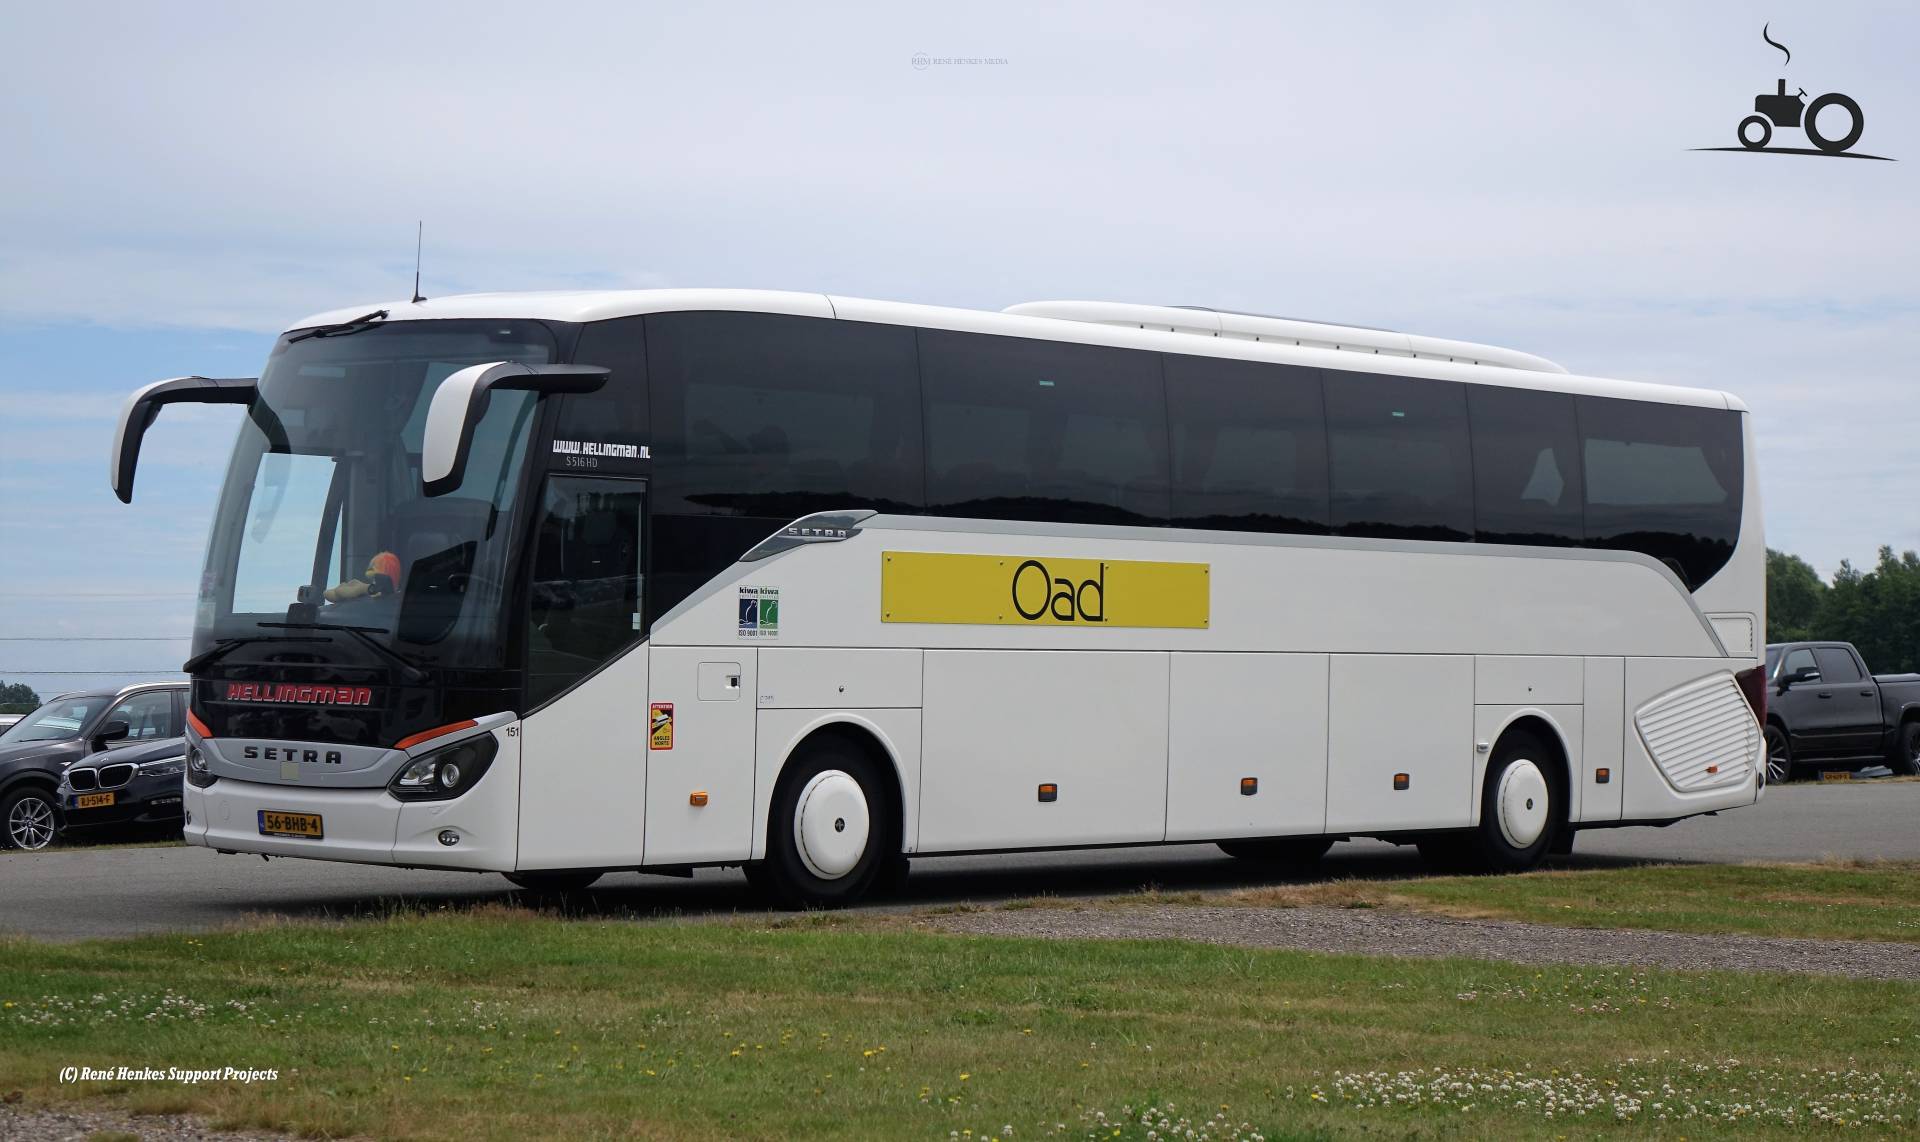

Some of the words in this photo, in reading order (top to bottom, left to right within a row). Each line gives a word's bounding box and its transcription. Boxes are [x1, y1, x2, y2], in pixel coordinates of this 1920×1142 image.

[586, 458, 598, 468] HD
[788, 527, 847, 538] SETRA
[1012, 560, 1104, 622] Oad
[505, 727, 519, 737] 151
[244, 746, 342, 764] SETRA
[266, 814, 319, 833] 56-BHB-4
